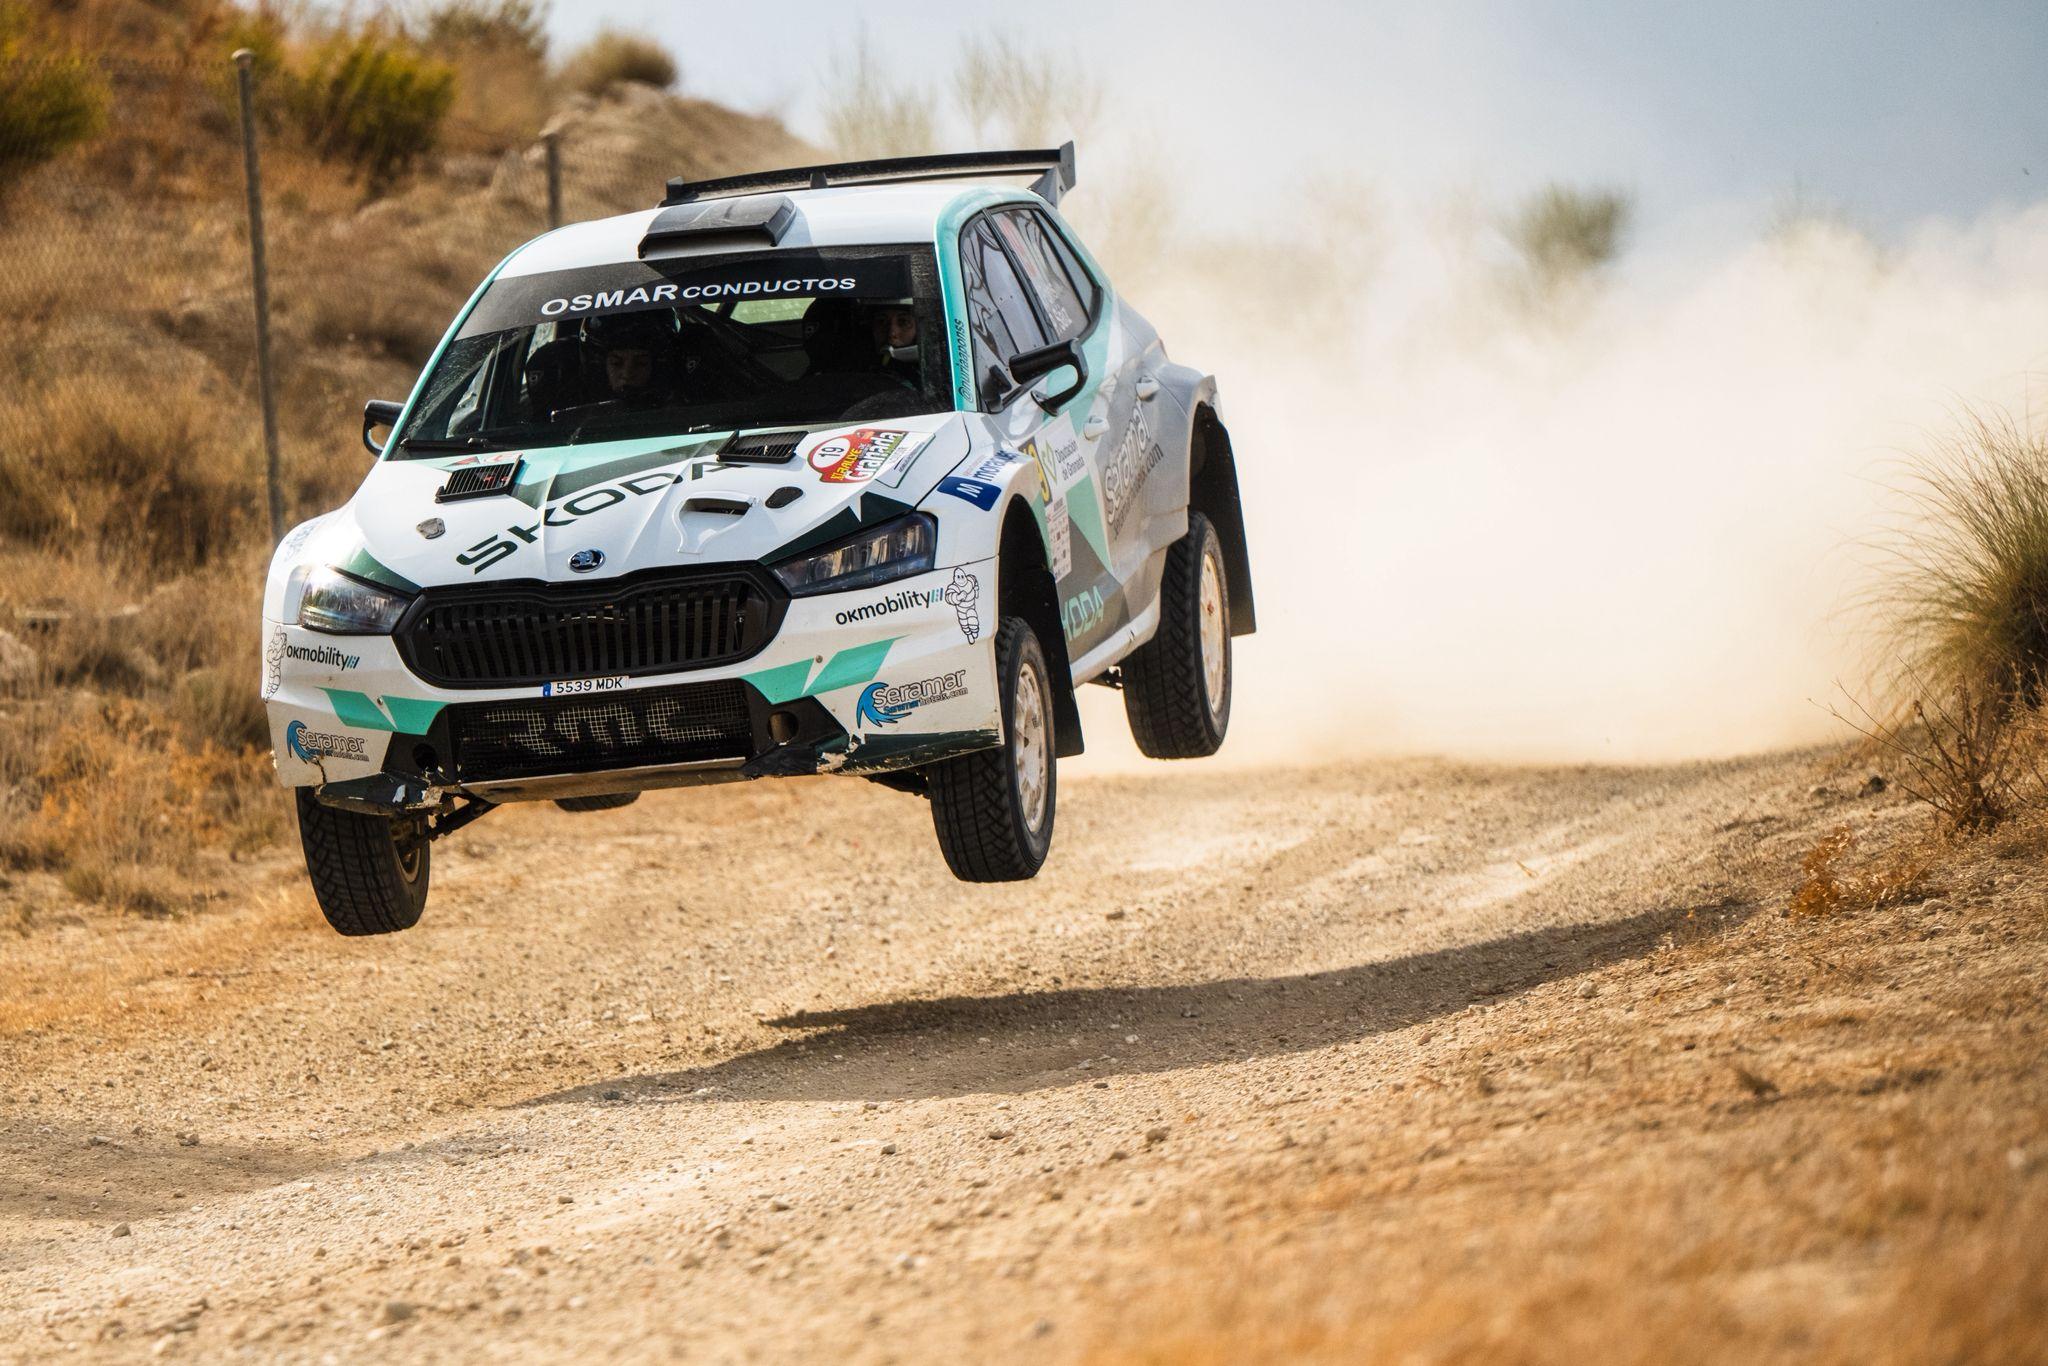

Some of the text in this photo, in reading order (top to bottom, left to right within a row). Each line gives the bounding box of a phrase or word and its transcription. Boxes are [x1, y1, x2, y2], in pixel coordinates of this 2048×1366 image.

[541, 278, 857, 316] OSMAR CONDUCTOS
[818, 446, 845, 458] 19
[845, 431, 906, 480] Granada
[956, 482, 984, 498] M
[555, 677, 624, 694] 5539 MDK
